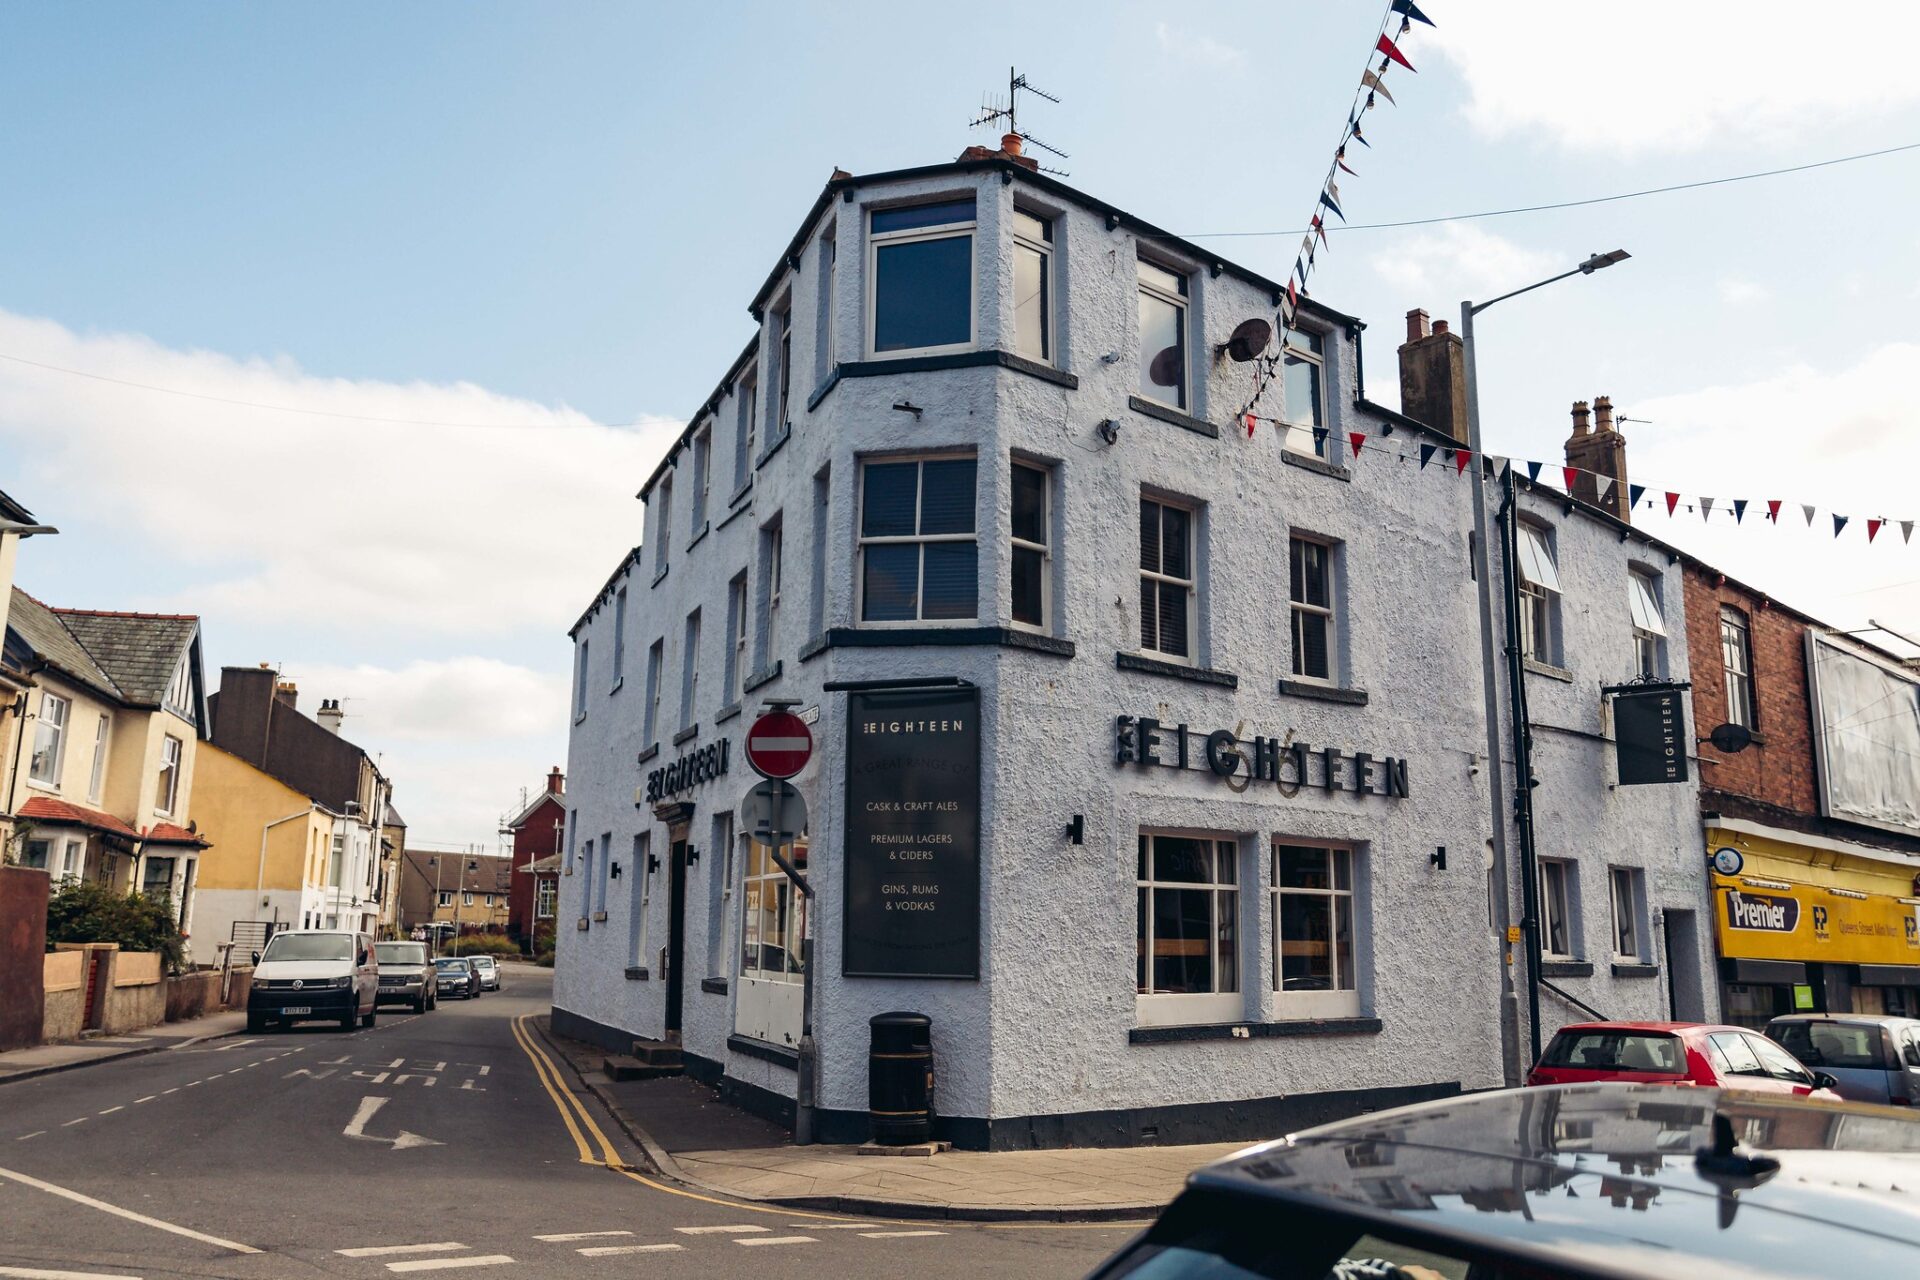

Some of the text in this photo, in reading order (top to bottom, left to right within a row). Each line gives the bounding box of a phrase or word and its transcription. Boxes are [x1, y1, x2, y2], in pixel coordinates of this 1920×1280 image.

[869, 719, 963, 734] EIGHTEEN
[1662, 698, 1675, 773] EIGHTEEN
[1117, 714, 1410, 799] BAR EIGHTEEN
[865, 759, 901, 773] GREAT
[905, 757, 948, 771] RANGE
[866, 802, 959, 812] CASK & CRAFT ALES
[870, 834, 953, 844] PREMIUM LAGERS
[889, 850, 934, 861] & CIDERS
[881, 884, 939, 896] GINS, RUMS
[885, 901, 935, 911] & VODKAS
[1734, 893, 1785, 928] Premier
